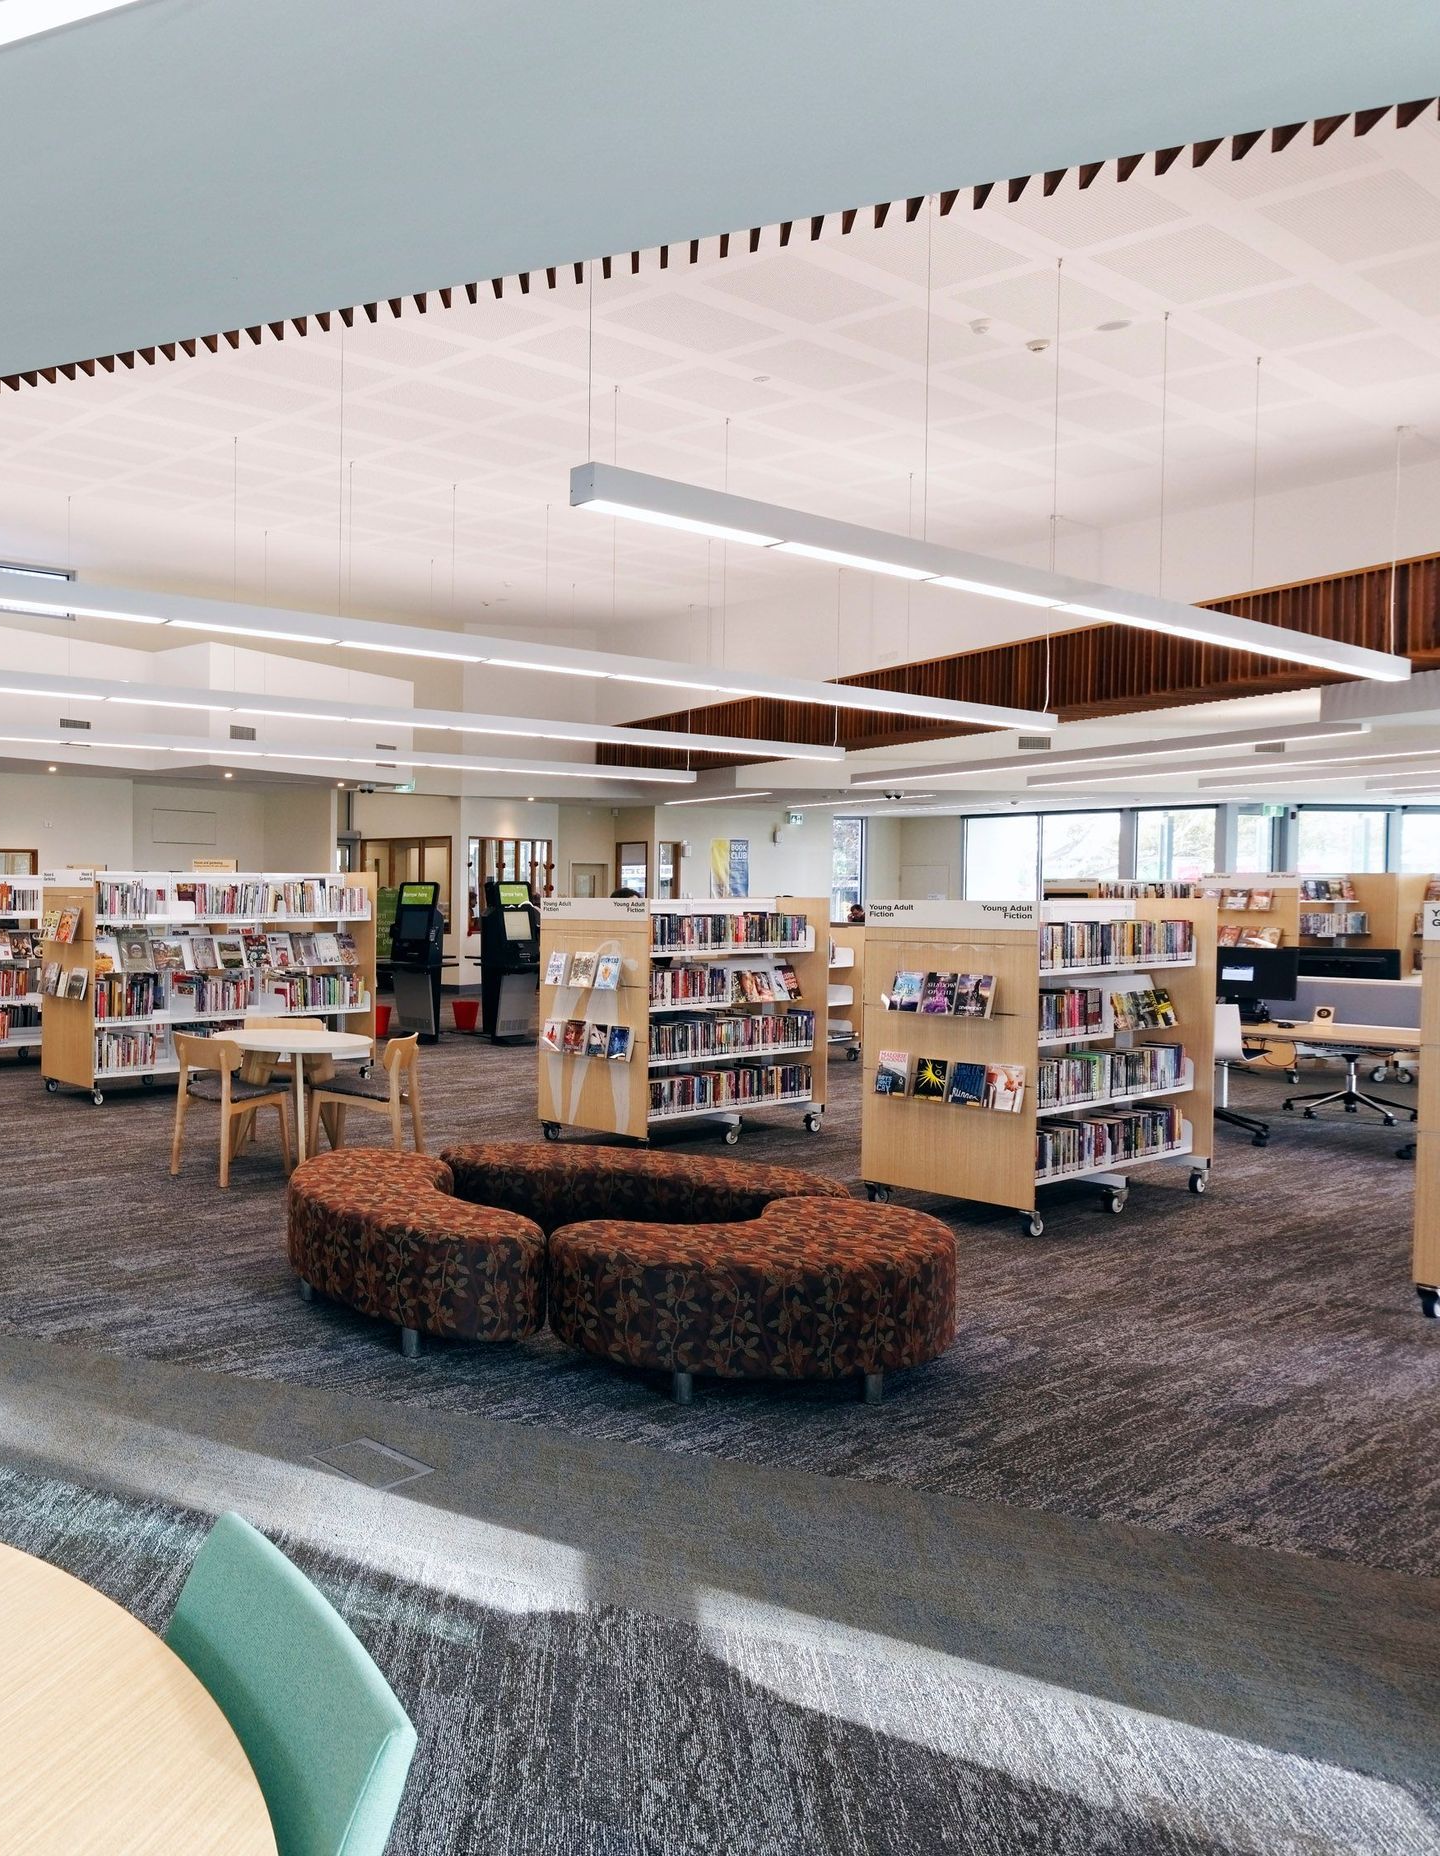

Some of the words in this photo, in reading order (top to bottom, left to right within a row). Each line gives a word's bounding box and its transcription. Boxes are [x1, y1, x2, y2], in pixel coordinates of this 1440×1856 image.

[730, 851, 747, 860] CLUB
[981, 904, 1008, 913] Young
[1009, 904, 1033, 912] Adult
[1003, 911, 1033, 919] Fiction
